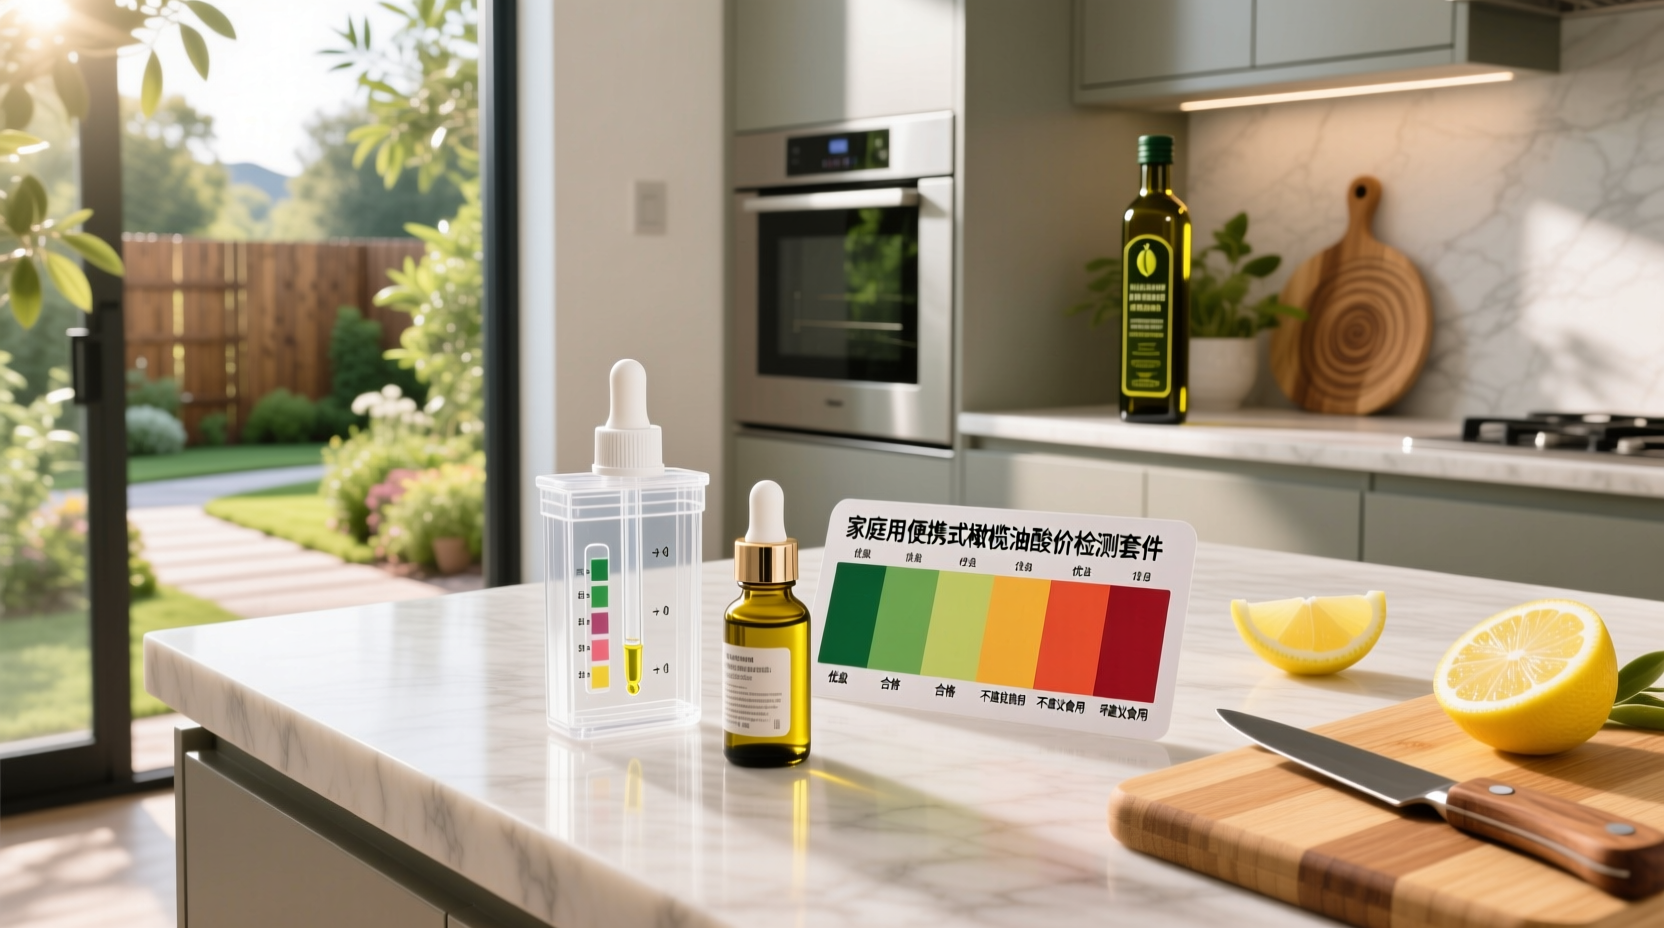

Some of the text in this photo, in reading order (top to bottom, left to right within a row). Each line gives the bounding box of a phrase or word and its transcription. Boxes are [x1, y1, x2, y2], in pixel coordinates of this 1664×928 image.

[845, 515, 1164, 561] 家庭用便携式橄榄油酸价检测套件
